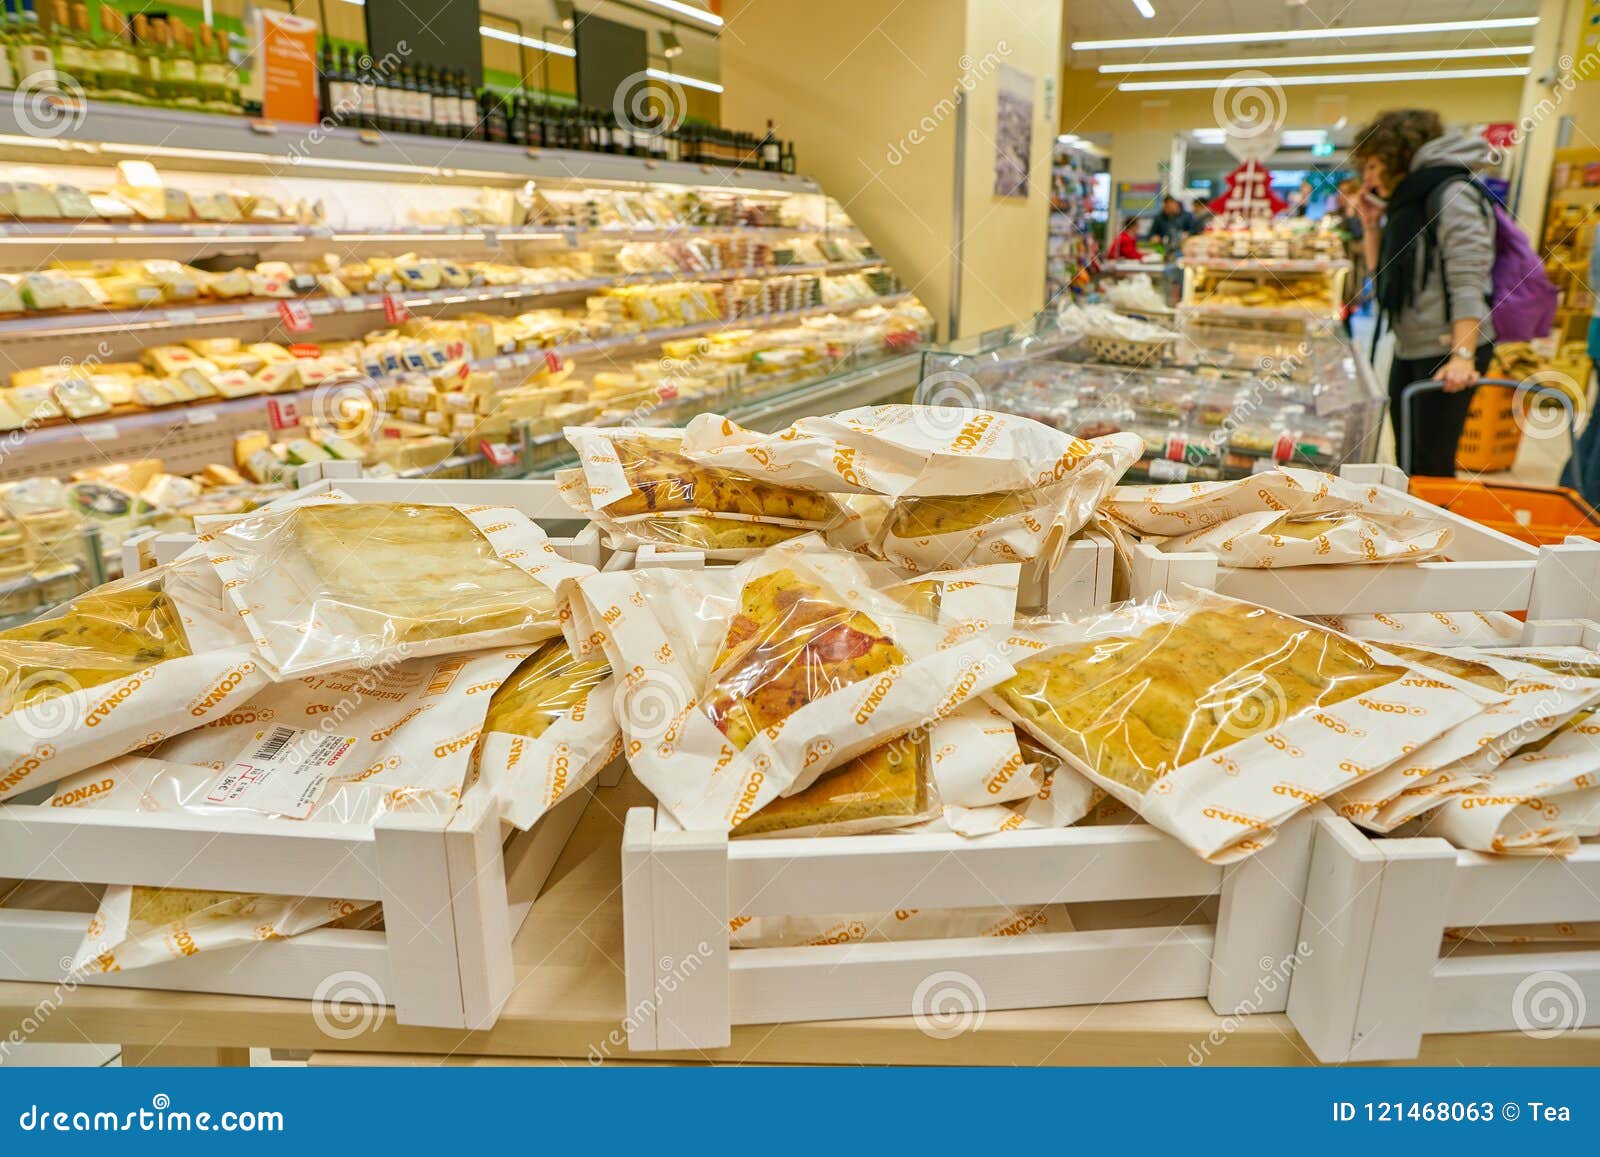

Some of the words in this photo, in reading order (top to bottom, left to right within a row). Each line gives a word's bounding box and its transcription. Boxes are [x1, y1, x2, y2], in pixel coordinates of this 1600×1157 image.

[84, 677, 141, 728] CONAD
[191, 670, 243, 717] CONAD
[325, 682, 354, 694] per
[855, 677, 894, 725] CONAD
[52, 778, 115, 808] CONAD
[550, 757, 569, 805] CONA
[732, 772, 764, 828] CONAD
